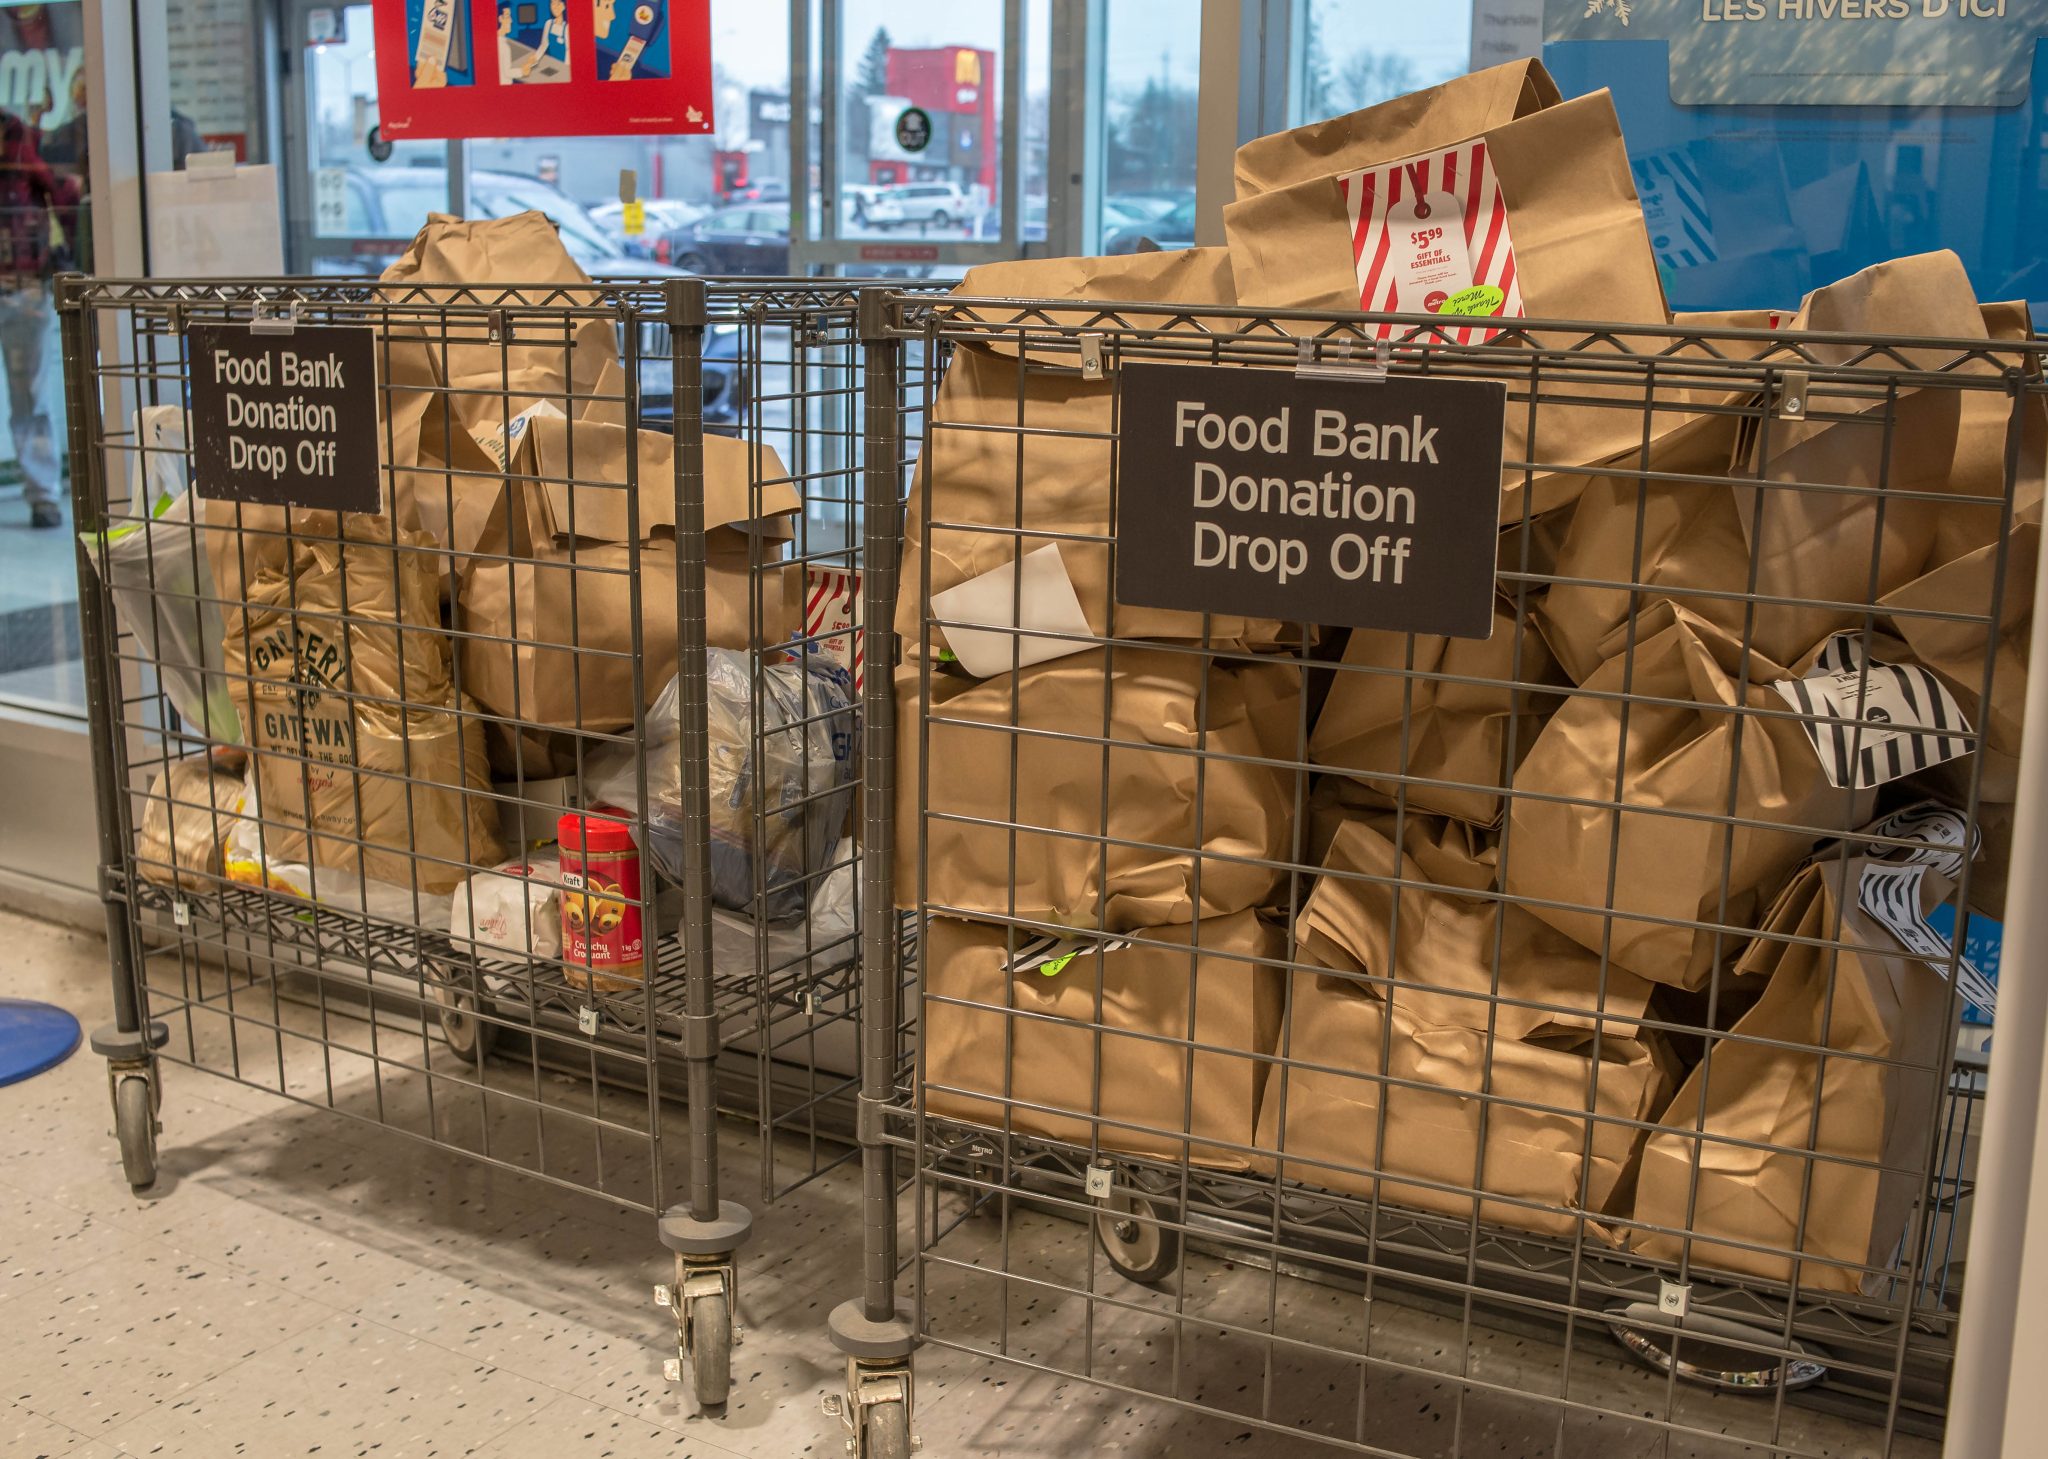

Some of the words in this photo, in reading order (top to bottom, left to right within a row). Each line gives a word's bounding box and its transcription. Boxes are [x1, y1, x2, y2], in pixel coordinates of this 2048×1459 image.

[1702, 0, 1767, 21] LES
[1778, 0, 1910, 20] HIVERS
[1922, 0, 2006, 18] DICI
[1410, 254, 1451, 269] ESSENTIALS
[1416, 251, 1432, 260] GIFT
[1433, 248, 1443, 257] OF
[214, 349, 271, 386] Food
[281, 351, 345, 388] Bank
[226, 392, 337, 433] Donation
[1175, 400, 1290, 454] Food
[1313, 409, 1439, 464] Bank
[229, 435, 287, 479] Drop
[296, 440, 336, 476] Off
[1193, 461, 1416, 524] Donation
[1193, 521, 1308, 585] Drop
[1330, 533, 1412, 584] Off
[319, 751, 334, 762] THE
[563, 874, 581, 886] Kraft
[573, 948, 611, 960] Crouant
[575, 940, 608, 953] Cruchy
[971, 1144, 993, 1155] METRO
